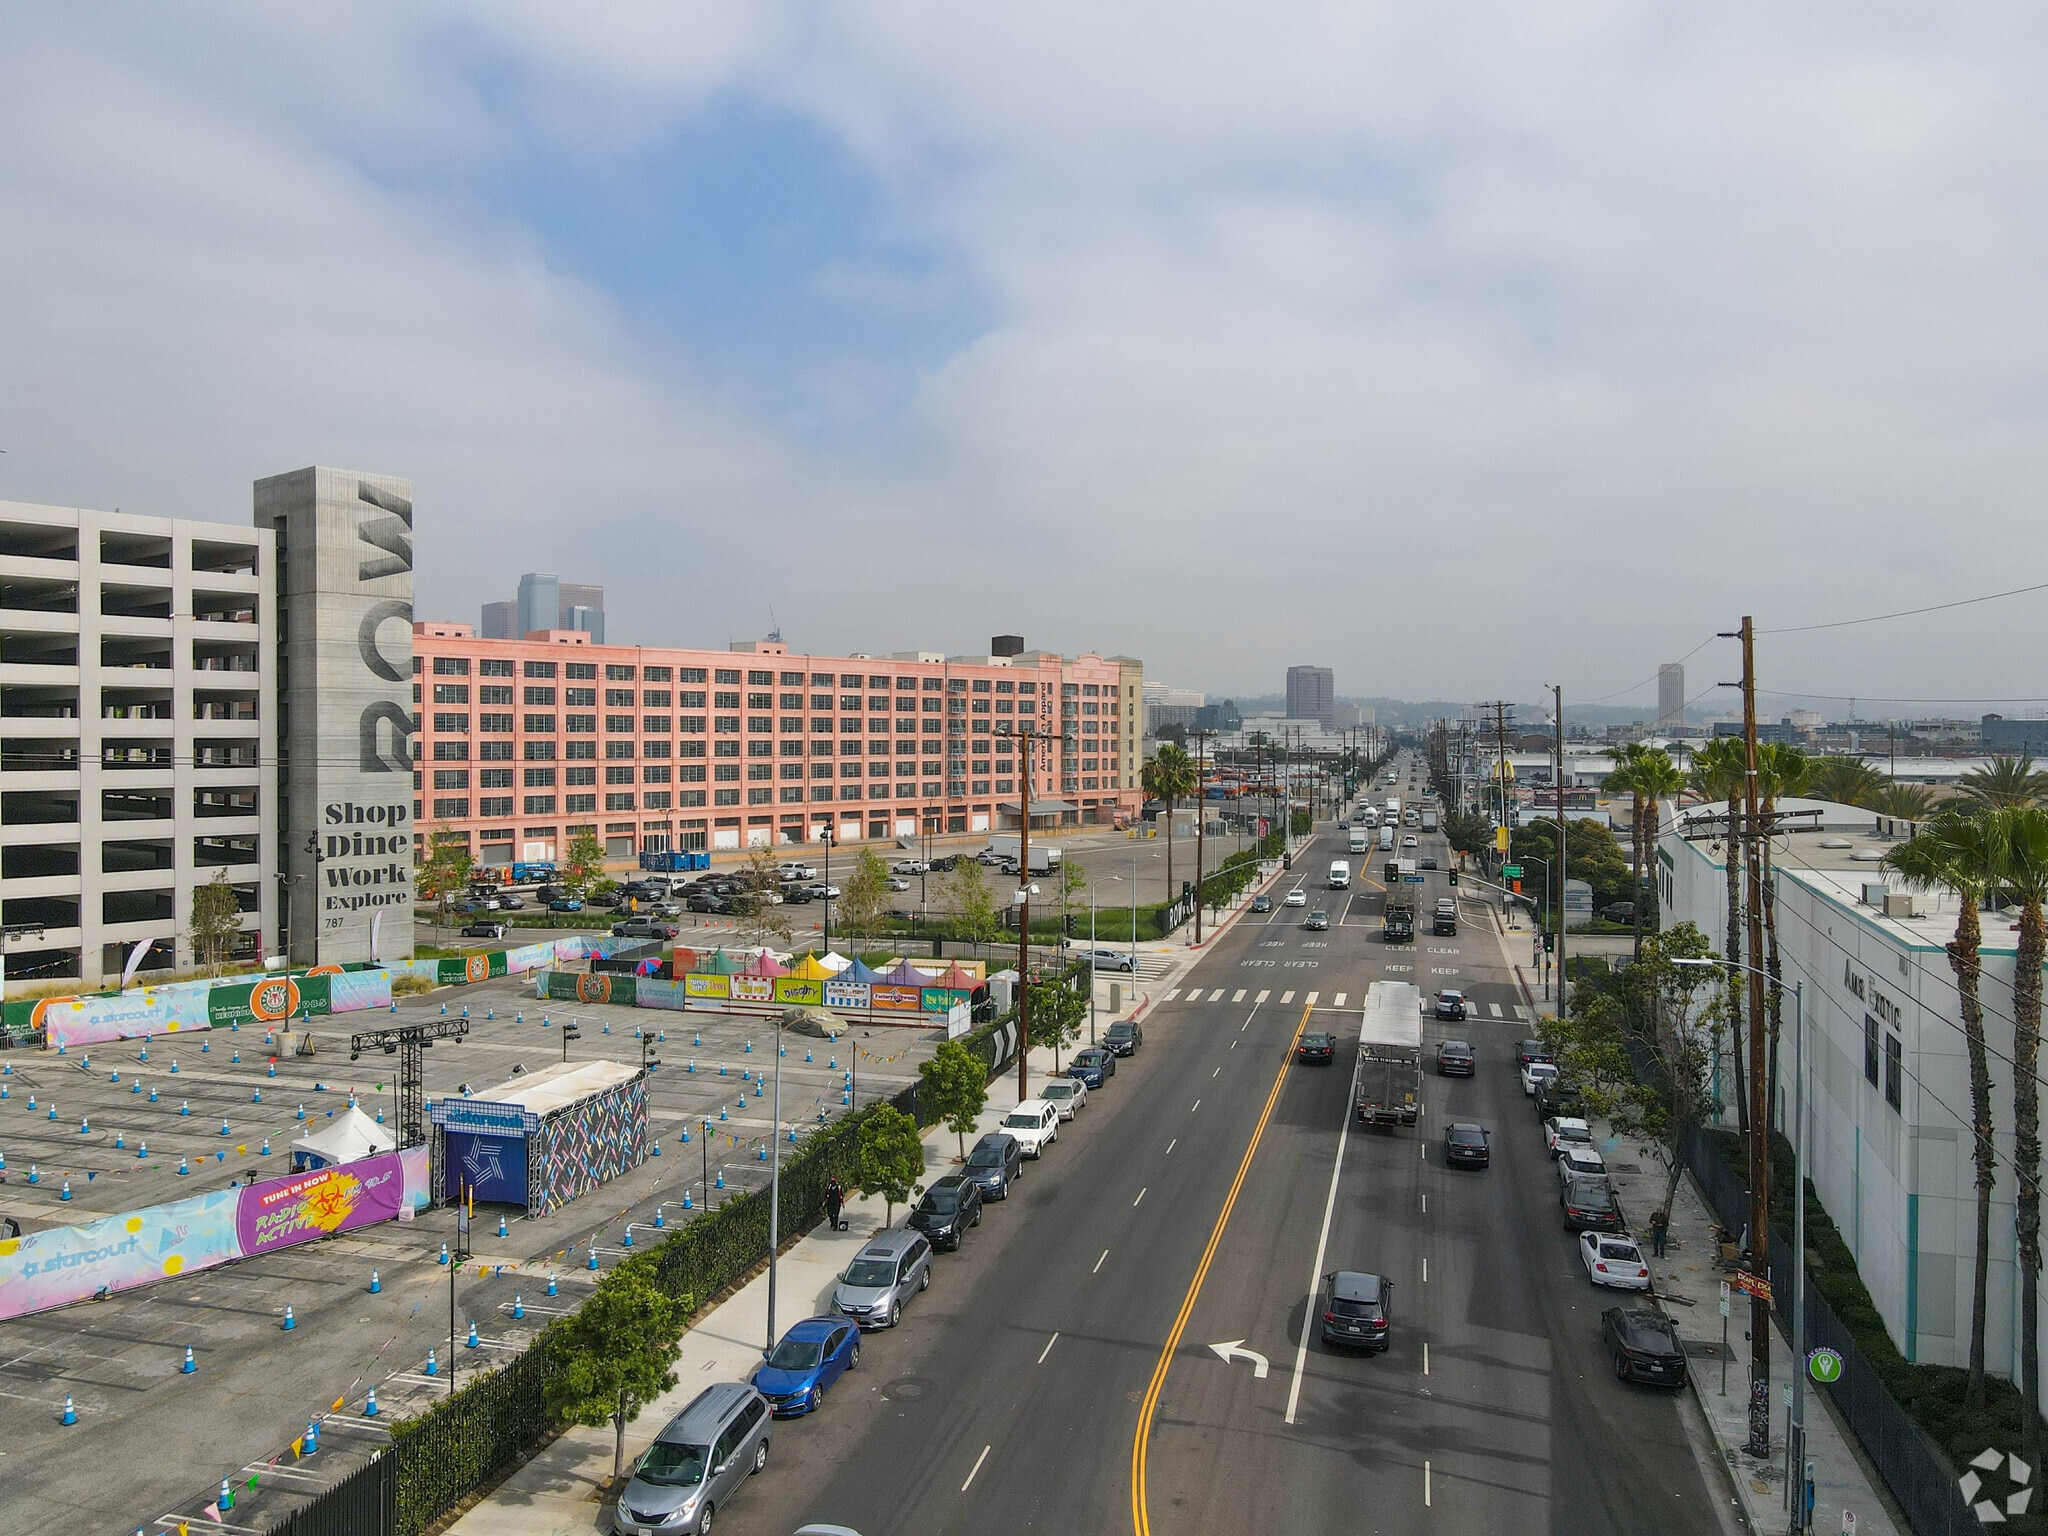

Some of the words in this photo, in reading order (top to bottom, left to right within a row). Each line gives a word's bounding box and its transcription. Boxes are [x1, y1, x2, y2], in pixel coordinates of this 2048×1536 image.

[358, 480, 413, 772] ROW
[325, 802, 407, 829] Shop
[326, 831, 407, 858] Dine
[326, 863, 407, 888] Work
[326, 892, 407, 912] Explore
[325, 917, 344, 928] 787
[1385, 945, 1418, 953] CLEAR
[1427, 947, 1460, 955] CLEAR
[1431, 967, 1459, 975] KEEP
[263, 1188, 289, 1205] TUNE
[291, 1184, 301, 1195] IN
[304, 1173, 329, 1190] NOW
[255, 1200, 308, 1232] RADIO
[255, 1212, 315, 1246] ACTIVE
[41, 1235, 139, 1273] starcourt
